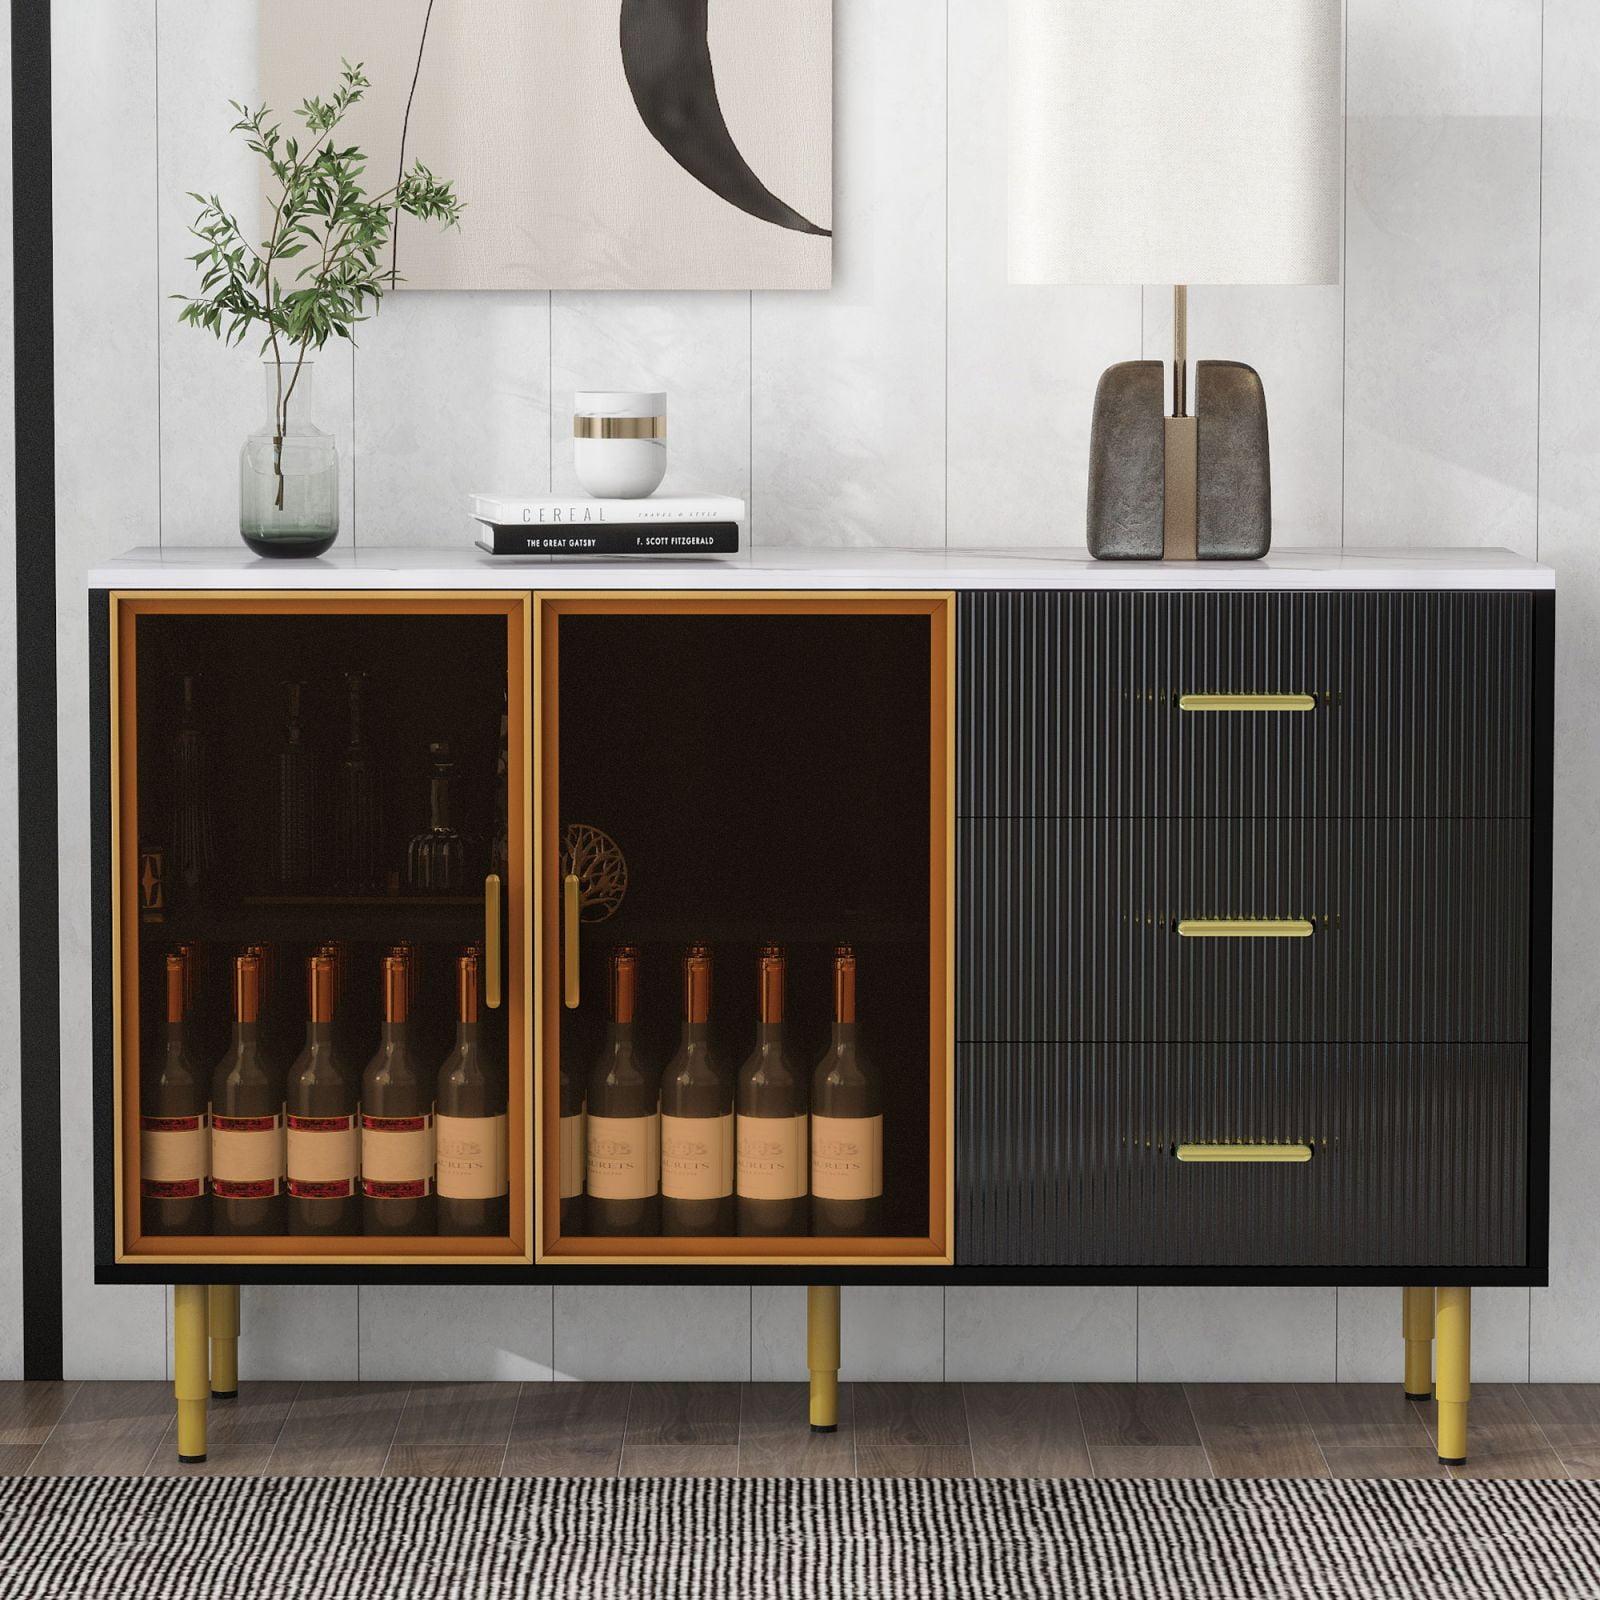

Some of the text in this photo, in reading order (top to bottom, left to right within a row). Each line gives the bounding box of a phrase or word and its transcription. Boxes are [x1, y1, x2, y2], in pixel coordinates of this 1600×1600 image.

[522, 507, 607, 523] CEREAL
[527, 538, 596, 548] THE GREAT GATSBY
[636, 536, 714, 545] F. SCOTT FITZGERALD
